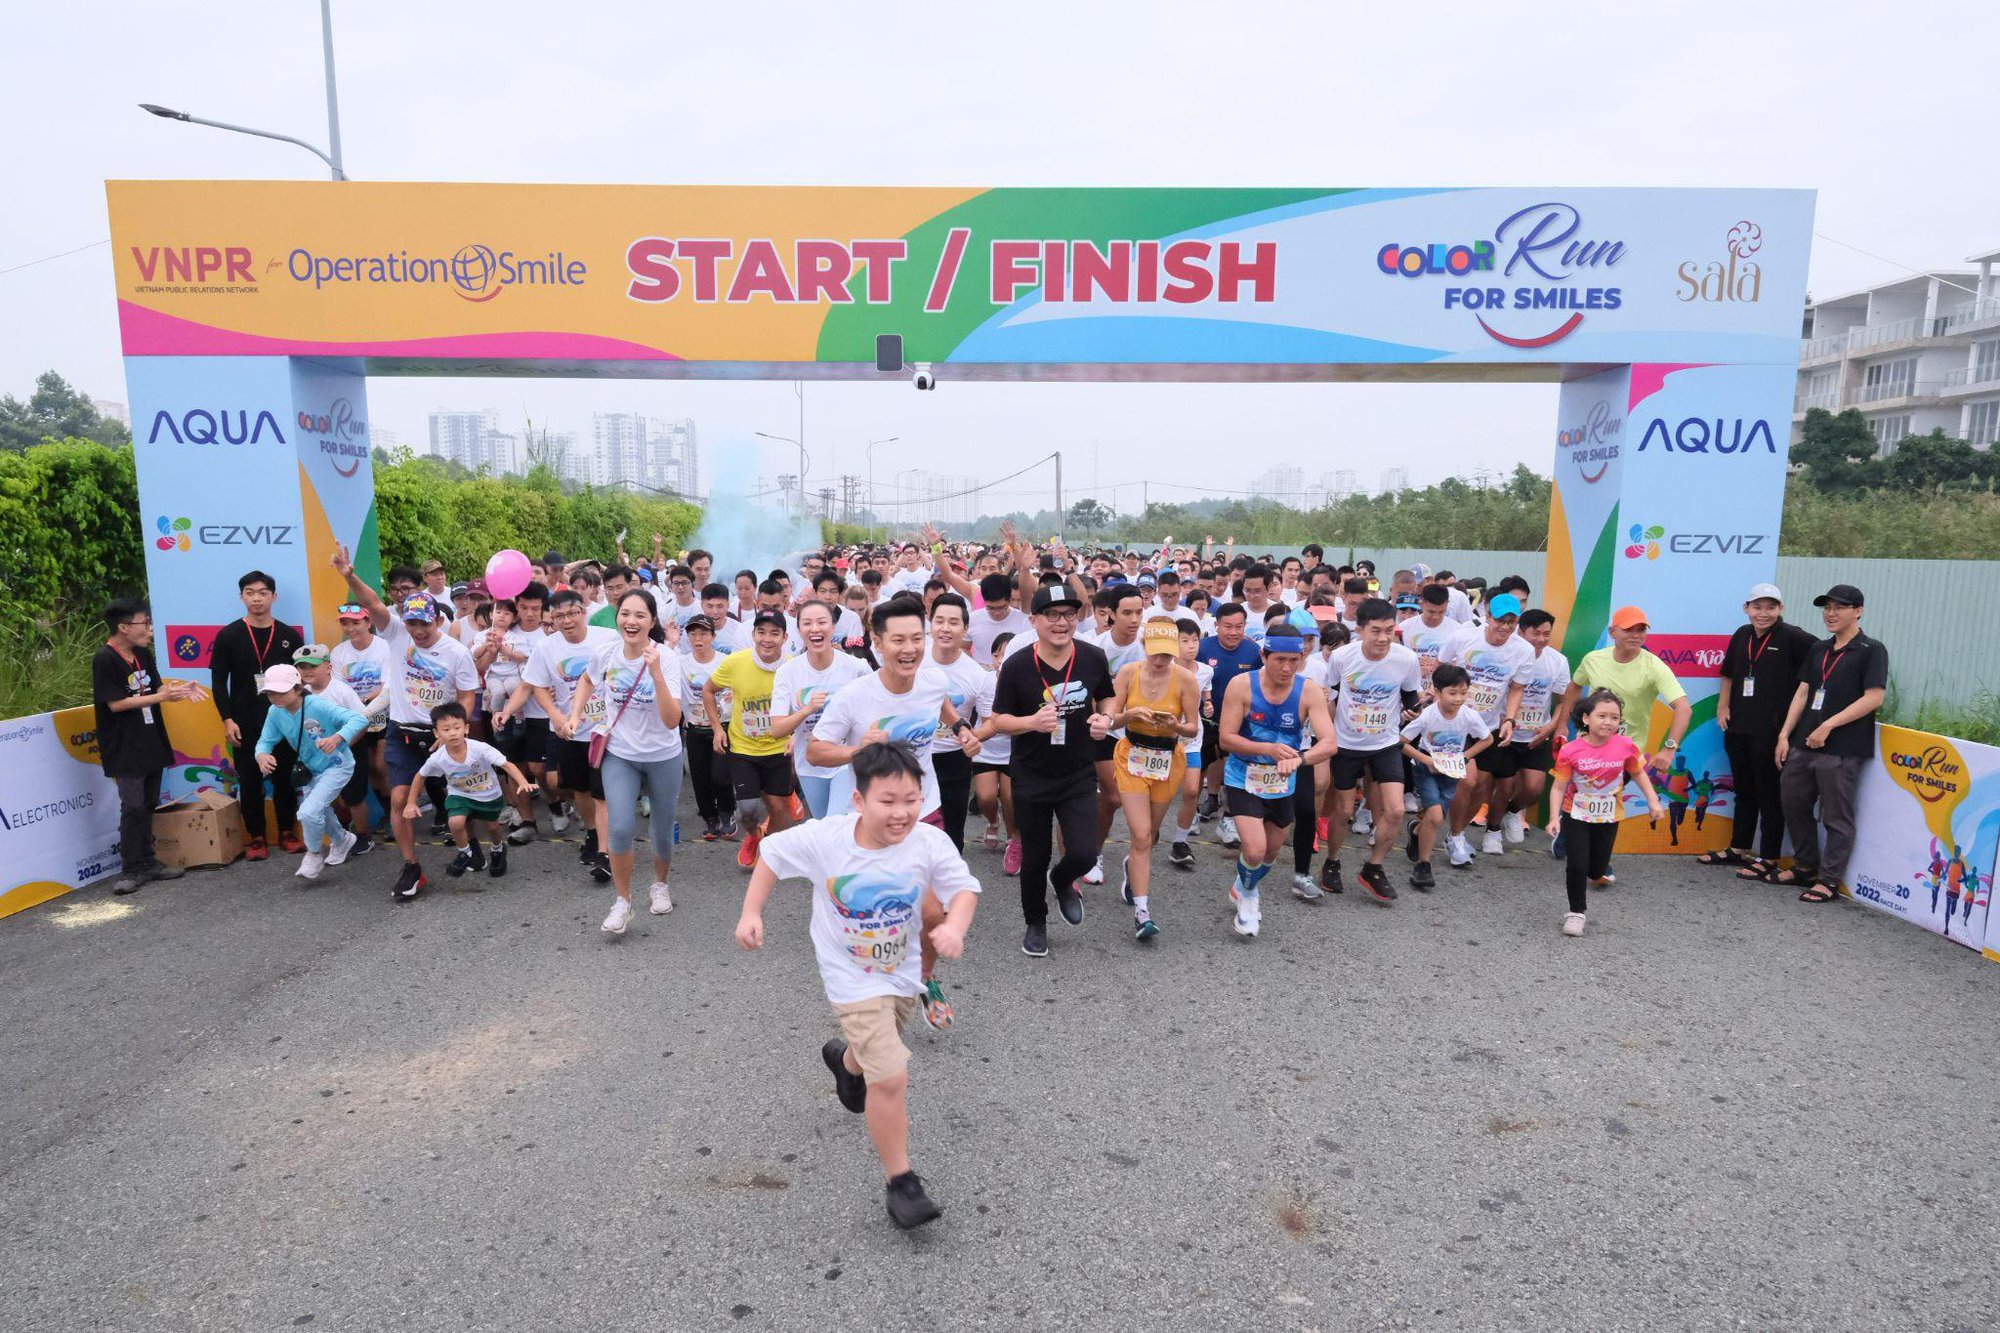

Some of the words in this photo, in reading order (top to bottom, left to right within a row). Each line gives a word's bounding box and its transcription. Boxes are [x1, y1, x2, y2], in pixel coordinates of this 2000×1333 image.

[1377, 240, 1495, 278] COLOR
[1495, 202, 1630, 281] Run
[131, 246, 257, 283] VNPR
[288, 248, 449, 287] Operation
[499, 250, 587, 285] Smile
[627, 236, 906, 305] START
[924, 228, 971, 312] /
[990, 239, 1277, 305] FINISH
[1676, 245, 1762, 303] sala
[1444, 287, 1504, 310] FOR
[1514, 287, 1622, 310] SMILES
[148, 408, 287, 446] AQUA
[298, 411, 333, 434] COLOR
[331, 398, 365, 441] Run
[1586, 400, 1621, 444] Run
[1637, 417, 1777, 454] AQUA
[320, 440, 338, 454] FOR
[339, 443, 368, 459] SMILES
[1572, 450, 1588, 464] FOR
[1589, 445, 1620, 461] SMILES
[199, 525, 294, 546] EZVIZ
[1669, 534, 1765, 555] EZVIZ
[419, 687, 444, 700] 0210
[1474, 693, 1498, 704] 0762
[583, 700, 606, 714] 0158
[1521, 711, 1542, 721] 1617
[757, 716, 772, 728] 111
[1364, 713, 1387, 725] 1448
[1144, 756, 1169, 771] 1804
[1891, 751, 1923, 769] COLOR
[1922, 746, 1960, 778] Run
[1907, 773, 1924, 785] FOR
[1926, 777, 1957, 793] SMILES
[12, 792, 94, 829] ELECTRONICS
[1588, 801, 1613, 814] 0121
[77, 862, 101, 881] 2022
[1855, 882, 1880, 902] 2022
[1857, 873, 1896, 894] NOVEMBER
[1895, 884, 1910, 899] 20
[859, 922, 881, 930] FOR
